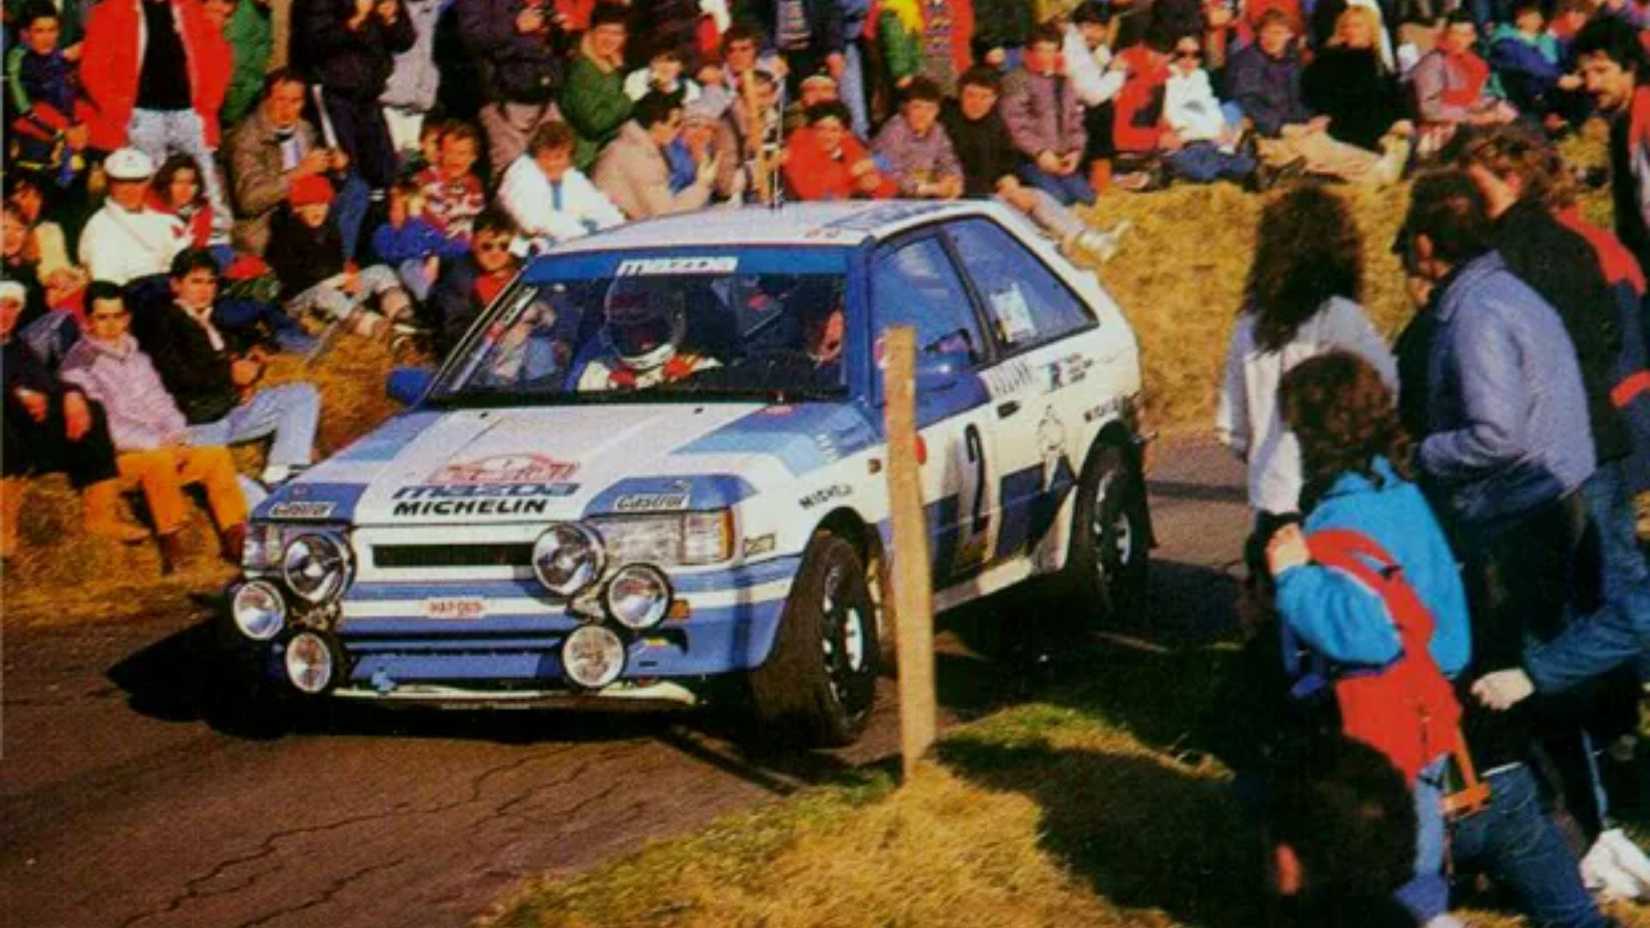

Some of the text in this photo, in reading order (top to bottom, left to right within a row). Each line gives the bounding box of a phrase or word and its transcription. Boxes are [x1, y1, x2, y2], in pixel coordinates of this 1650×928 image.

[616, 257, 738, 276] mazda
[392, 483, 580, 499] mazda
[393, 498, 549, 516] MICHELIN
[617, 494, 684, 510] Castrol
